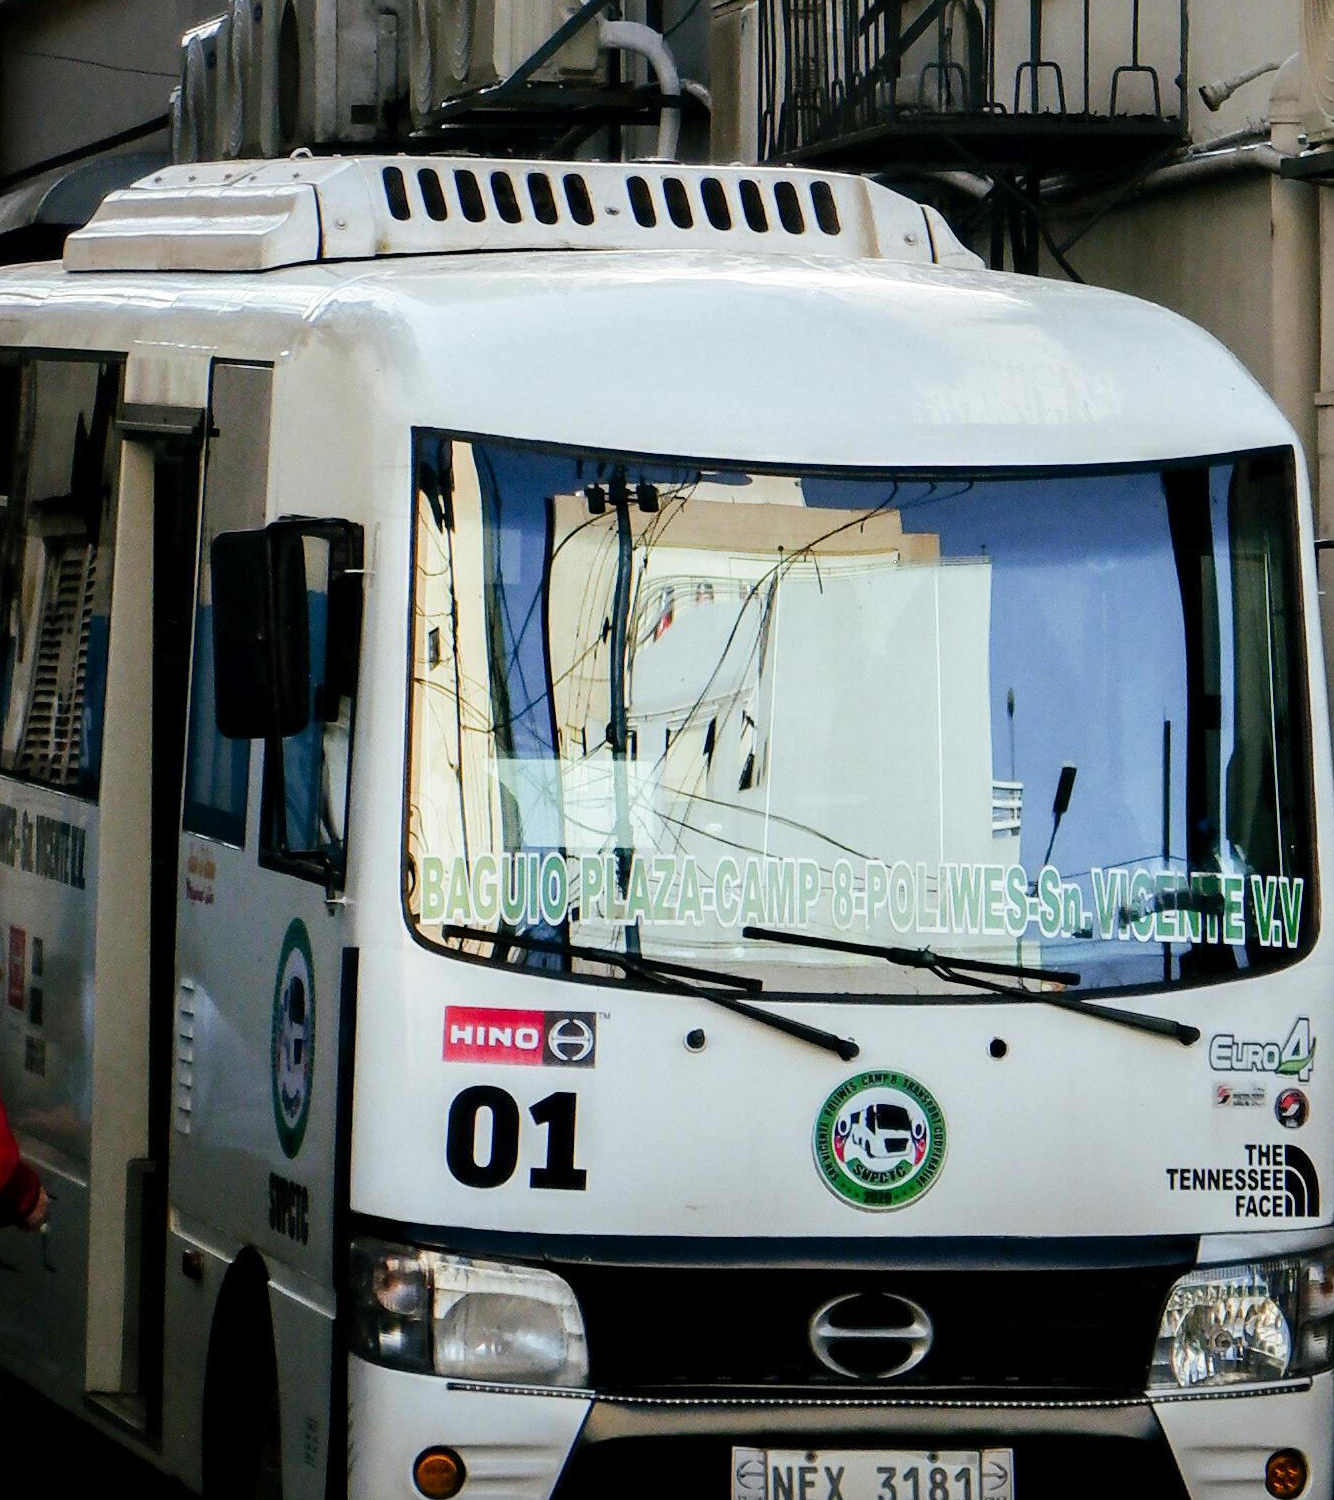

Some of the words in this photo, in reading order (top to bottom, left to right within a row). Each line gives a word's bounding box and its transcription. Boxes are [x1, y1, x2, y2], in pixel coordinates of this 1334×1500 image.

[418, 851, 569, 927] BAGUIO
[578, 854, 820, 930] PLAZA-CAMP
[1250, 874, 1305, 949] V.V
[449, 1023, 540, 1050] HINO
[446, 1085, 587, 1191] 01
[1244, 1144, 1284, 1167] THE
[1165, 1168, 1284, 1191] TENNESSEE
[1235, 1194, 1284, 1218] FACE
